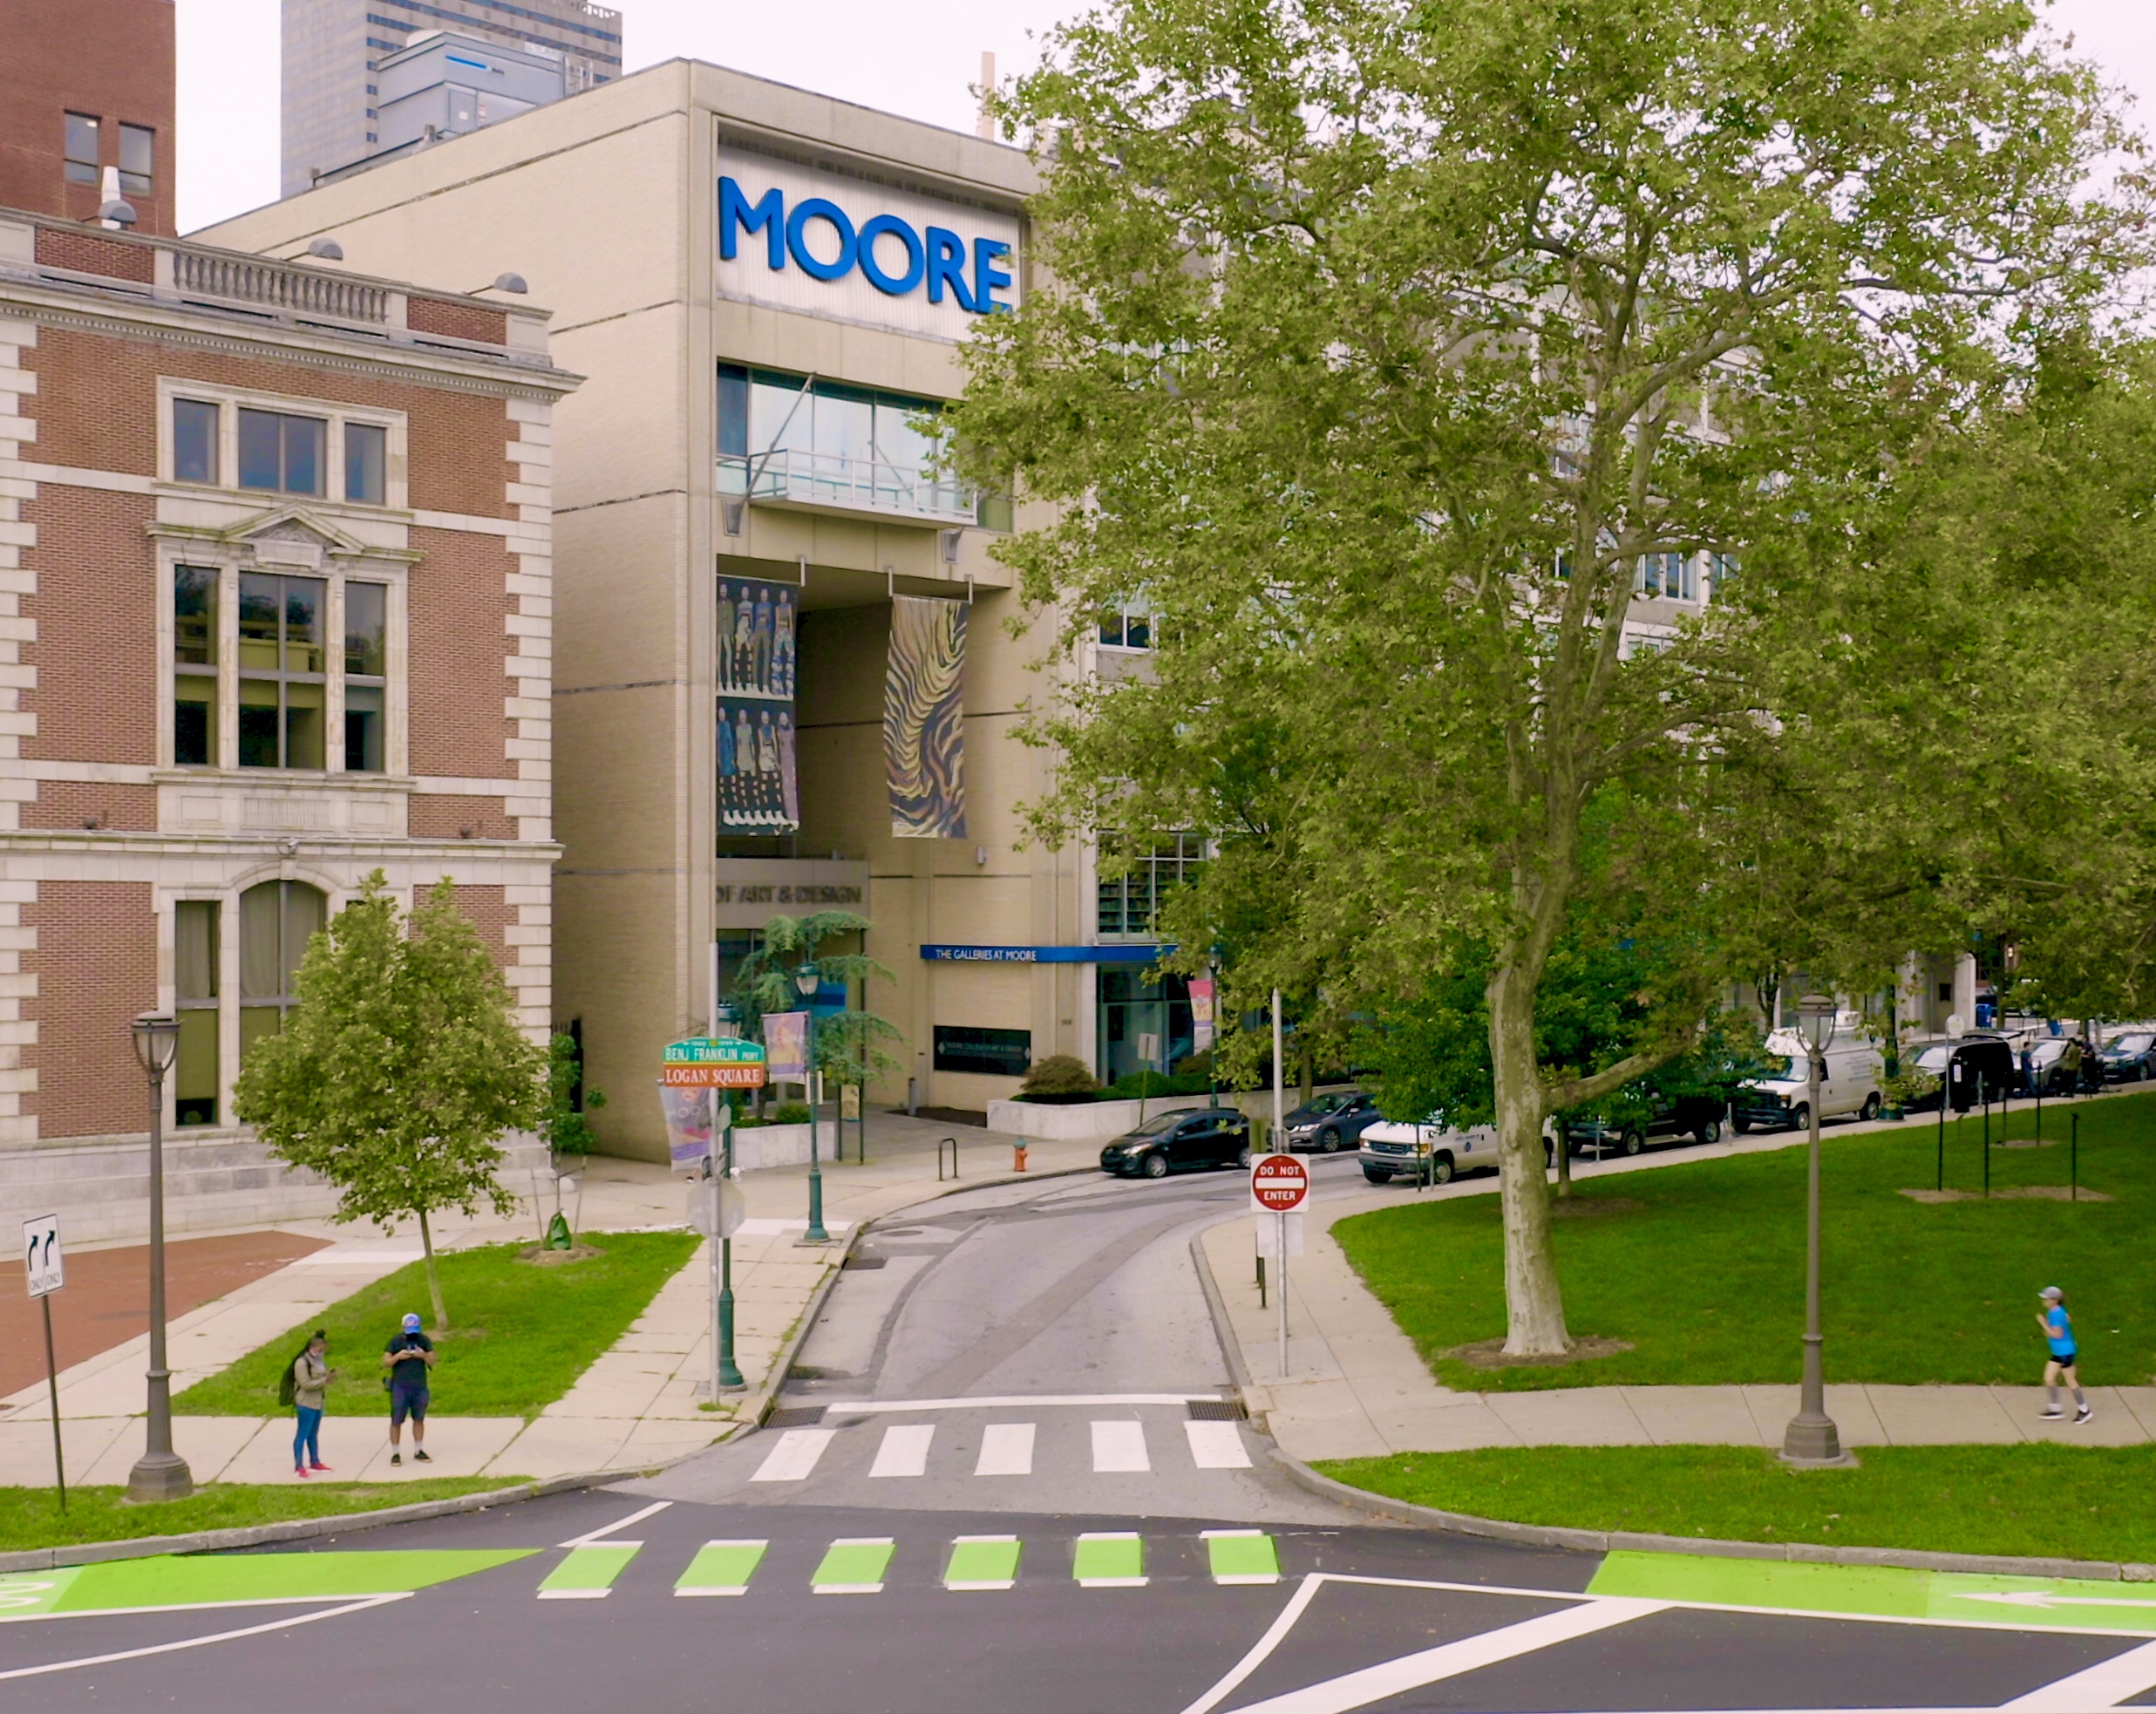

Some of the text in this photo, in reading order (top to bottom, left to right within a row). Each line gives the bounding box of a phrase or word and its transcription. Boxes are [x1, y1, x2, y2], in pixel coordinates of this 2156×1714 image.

[718, 176, 1013, 315] MOORE
[738, 885, 777, 903] ART
[778, 885, 793, 903] &
[795, 885, 861, 904] DESIGN
[935, 949, 1037, 962] THE GALLERIES AT MOORE
[665, 1048, 758, 1061] BENJ FRANKLIN PKWY
[665, 1069, 759, 1086] LOGAN SQUARE
[1260, 1166, 1300, 1176] DO NOT
[1264, 1191, 1296, 1200] ENTER
